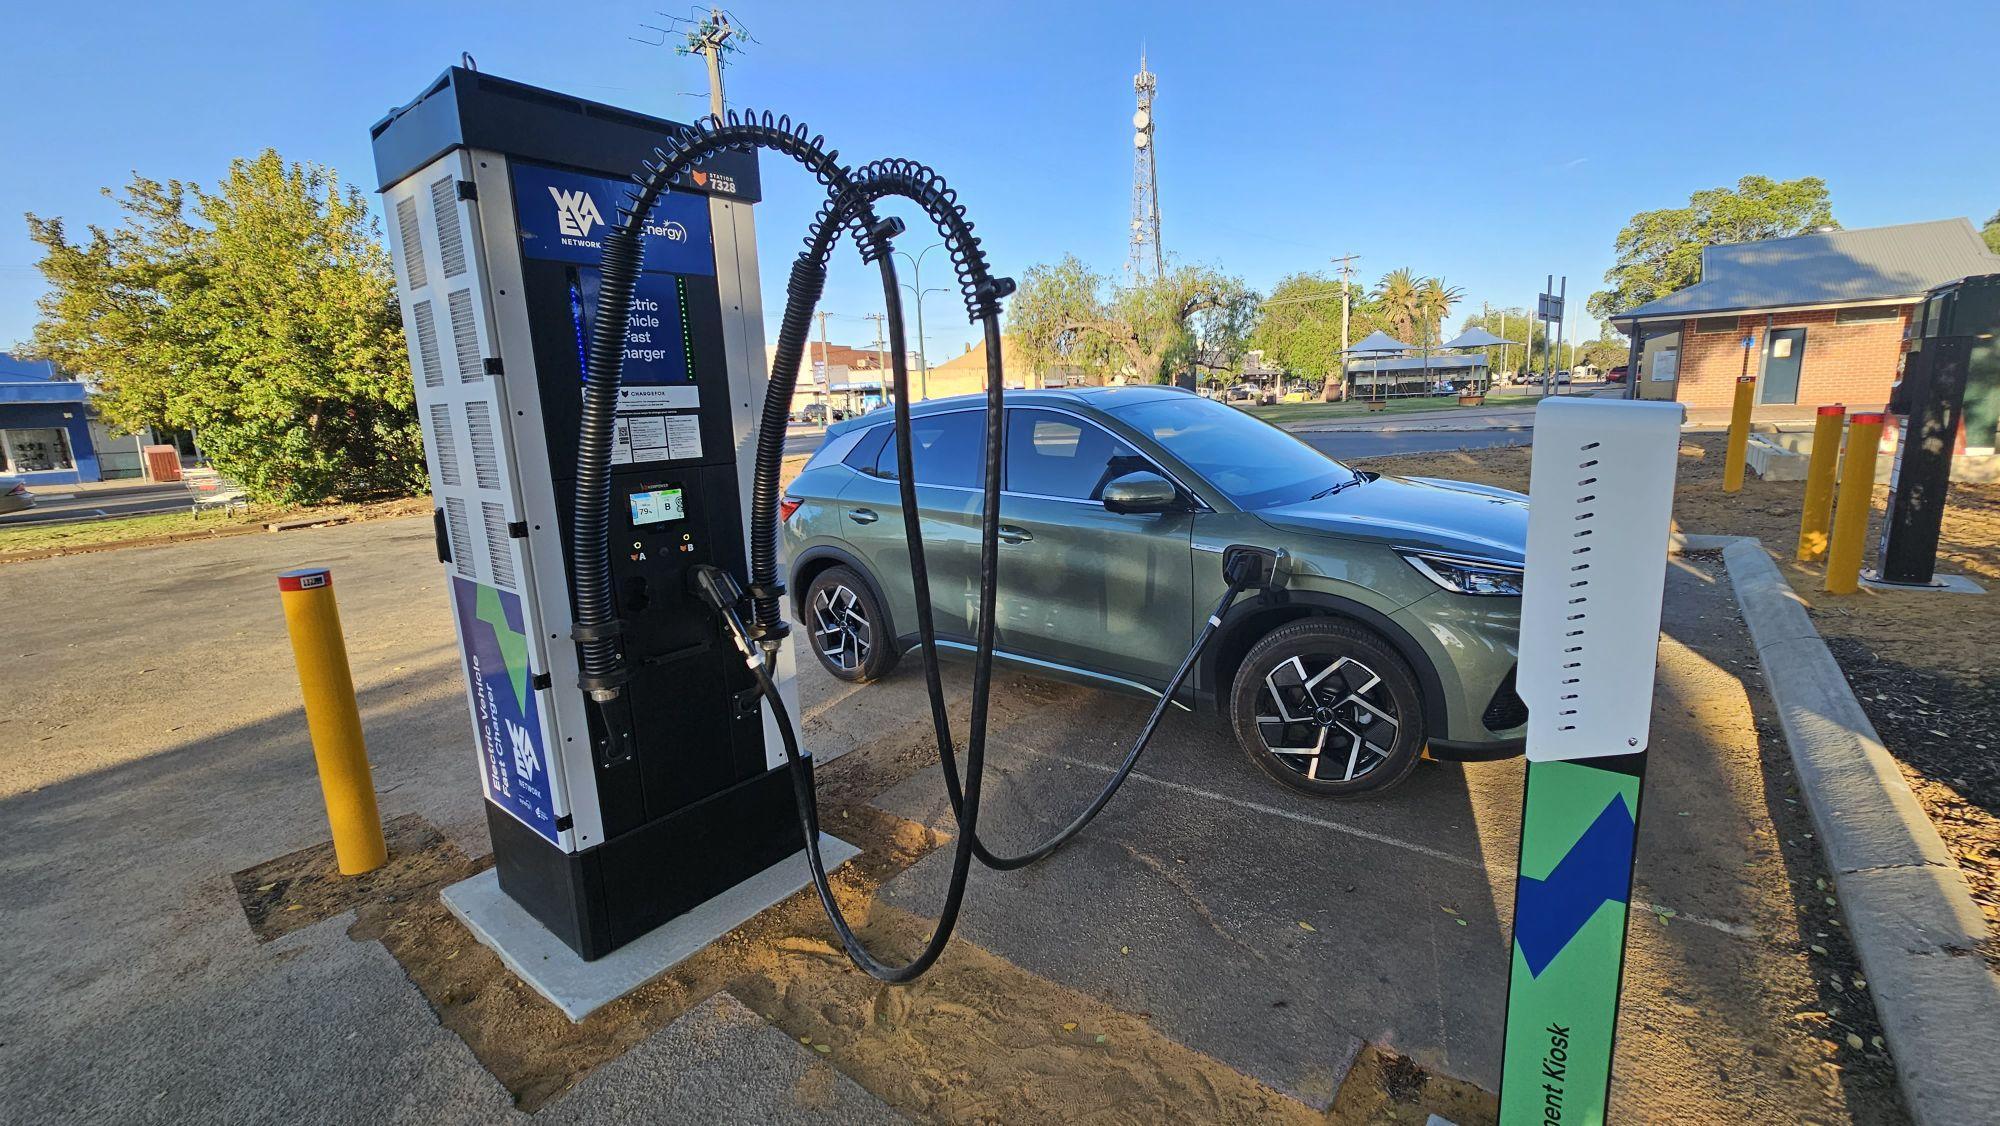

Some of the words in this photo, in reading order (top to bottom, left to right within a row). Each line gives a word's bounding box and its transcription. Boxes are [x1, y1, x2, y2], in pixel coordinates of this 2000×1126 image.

[709, 173, 734, 181] STATION
[711, 179, 736, 194] 7328
[561, 238, 601, 249] NETWORK
[641, 225, 683, 241] nergy
[639, 552, 646, 560] A
[472, 654, 488, 720] Vehicle
[487, 682, 504, 757] Charger
[484, 725, 501, 792] Electric
[497, 758, 511, 798] Fast
[518, 778, 542, 799] NETWORK
[1542, 1022, 1570, 1082] Kiosk
[1542, 1084, 1563, 1126] ent
